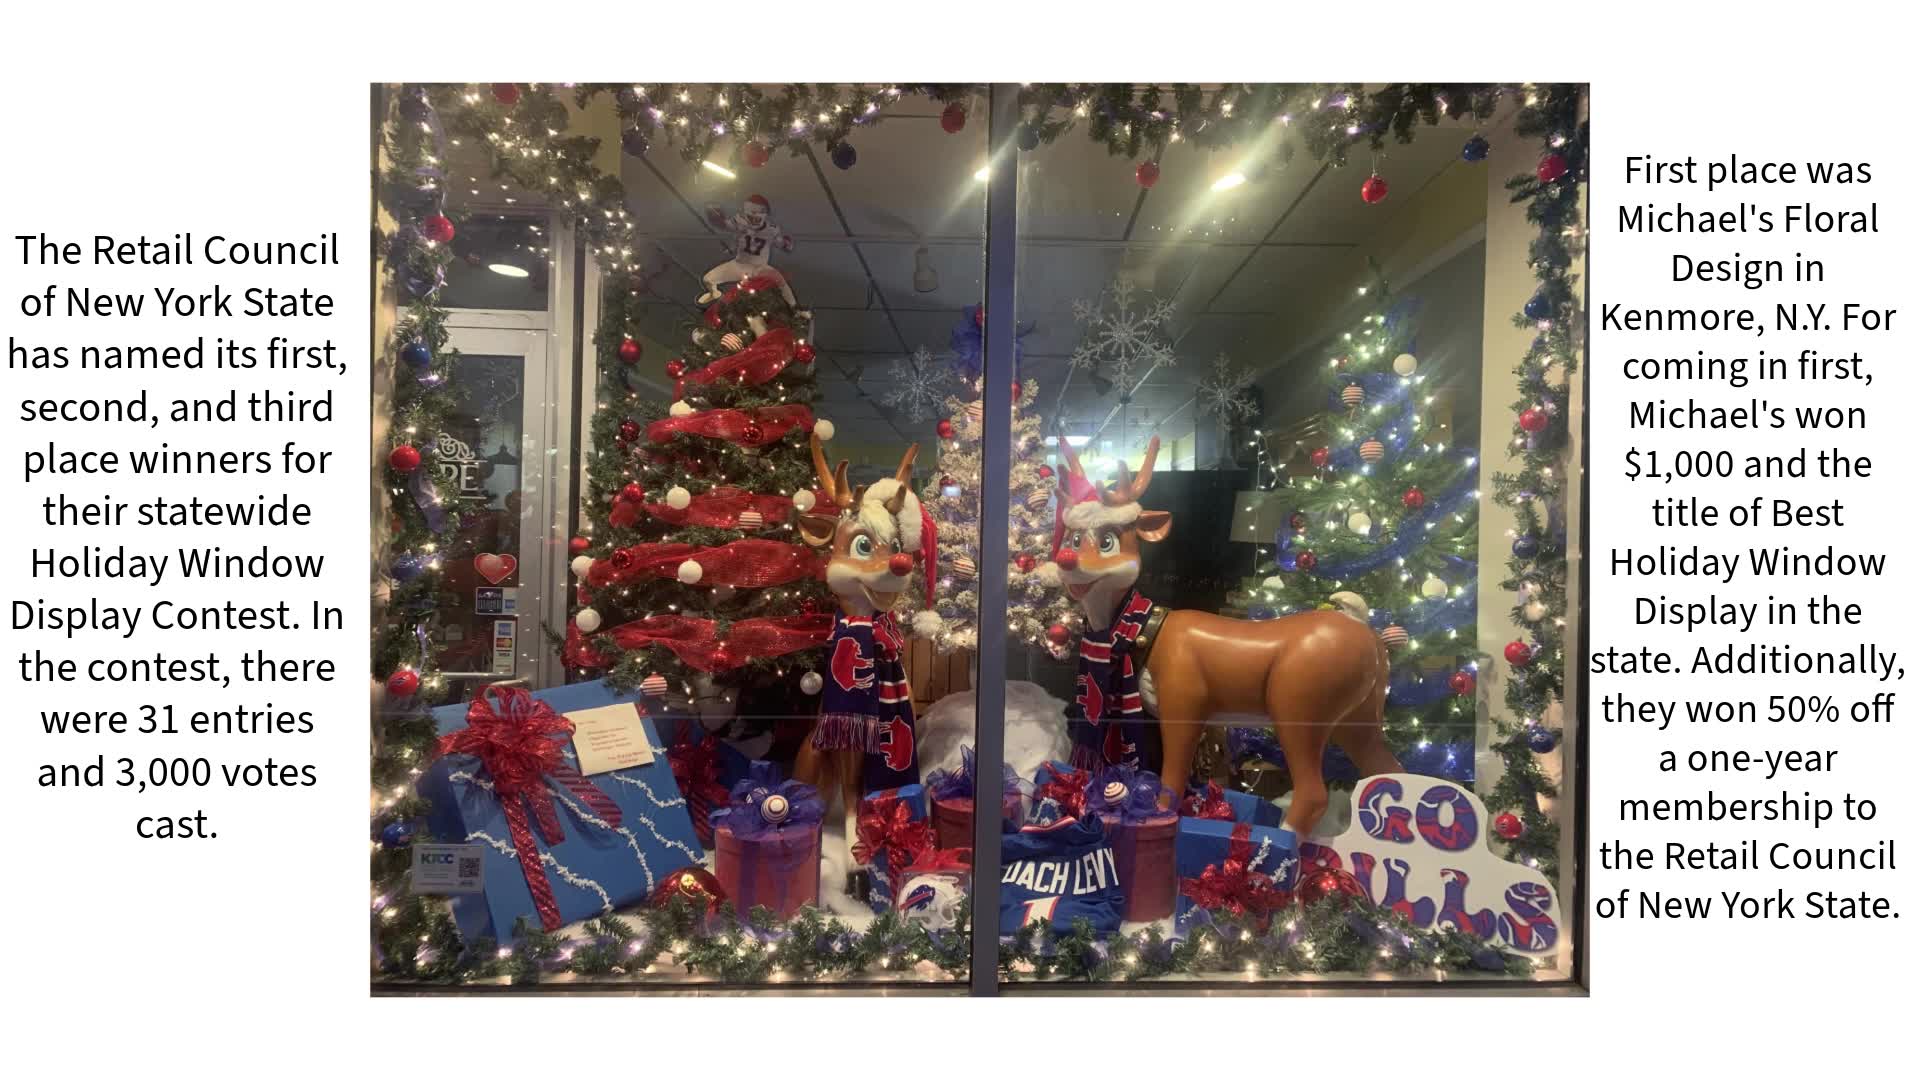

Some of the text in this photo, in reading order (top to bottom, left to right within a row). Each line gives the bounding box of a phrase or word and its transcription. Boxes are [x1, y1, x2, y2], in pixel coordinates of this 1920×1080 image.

[743, 234, 767, 256] 17
[1358, 777, 1479, 851] GO
[1001, 847, 1120, 895] OACH LEVY
